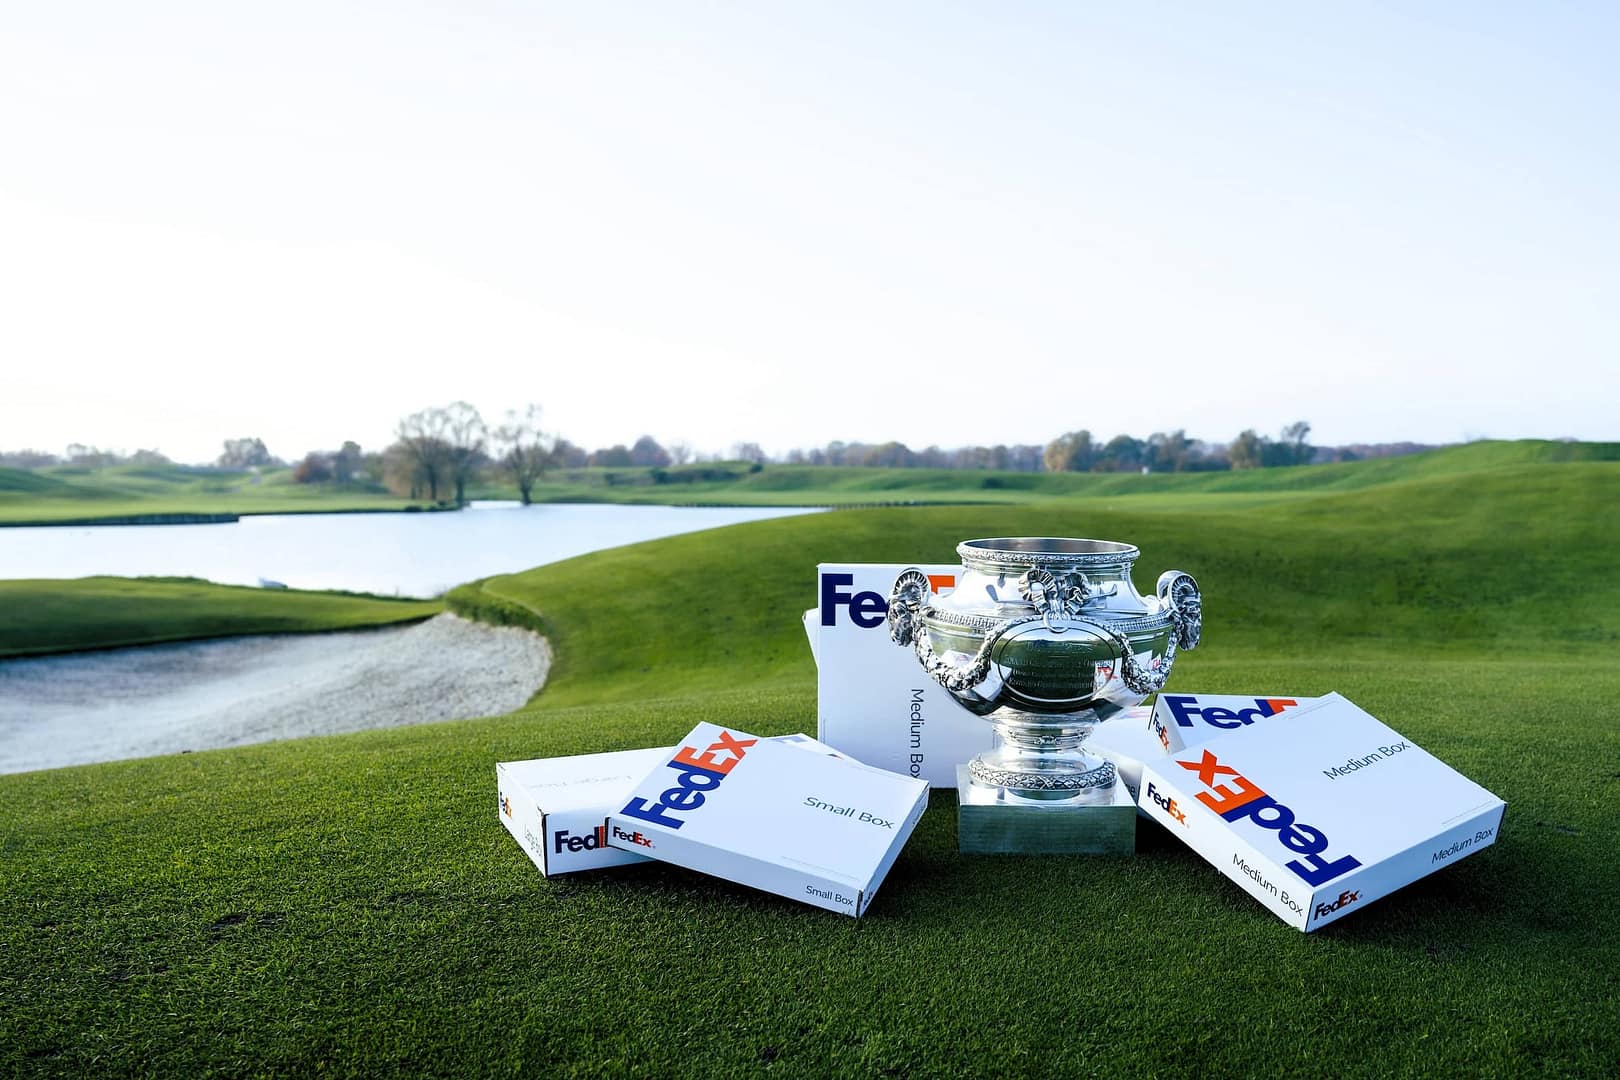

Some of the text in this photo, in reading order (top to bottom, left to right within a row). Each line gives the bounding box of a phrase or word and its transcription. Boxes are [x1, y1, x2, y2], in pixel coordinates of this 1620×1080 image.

[910, 688, 925, 749] Medium
[1153, 711, 1170, 750] FedEx
[619, 731, 758, 829] FedEx
[1322, 740, 1411, 781] Medium Box
[803, 796, 855, 818] Small
[858, 811, 895, 829] Box
[1146, 782, 1187, 826] FedEx
[1175, 748, 1363, 888] FedEx
[612, 826, 653, 848] FedEx
[1431, 826, 1494, 864] Medium Box
[805, 885, 833, 901] Small
[834, 893, 854, 907] Box
[1232, 852, 1304, 918] Medium Box
[1313, 888, 1361, 921] FedEx
